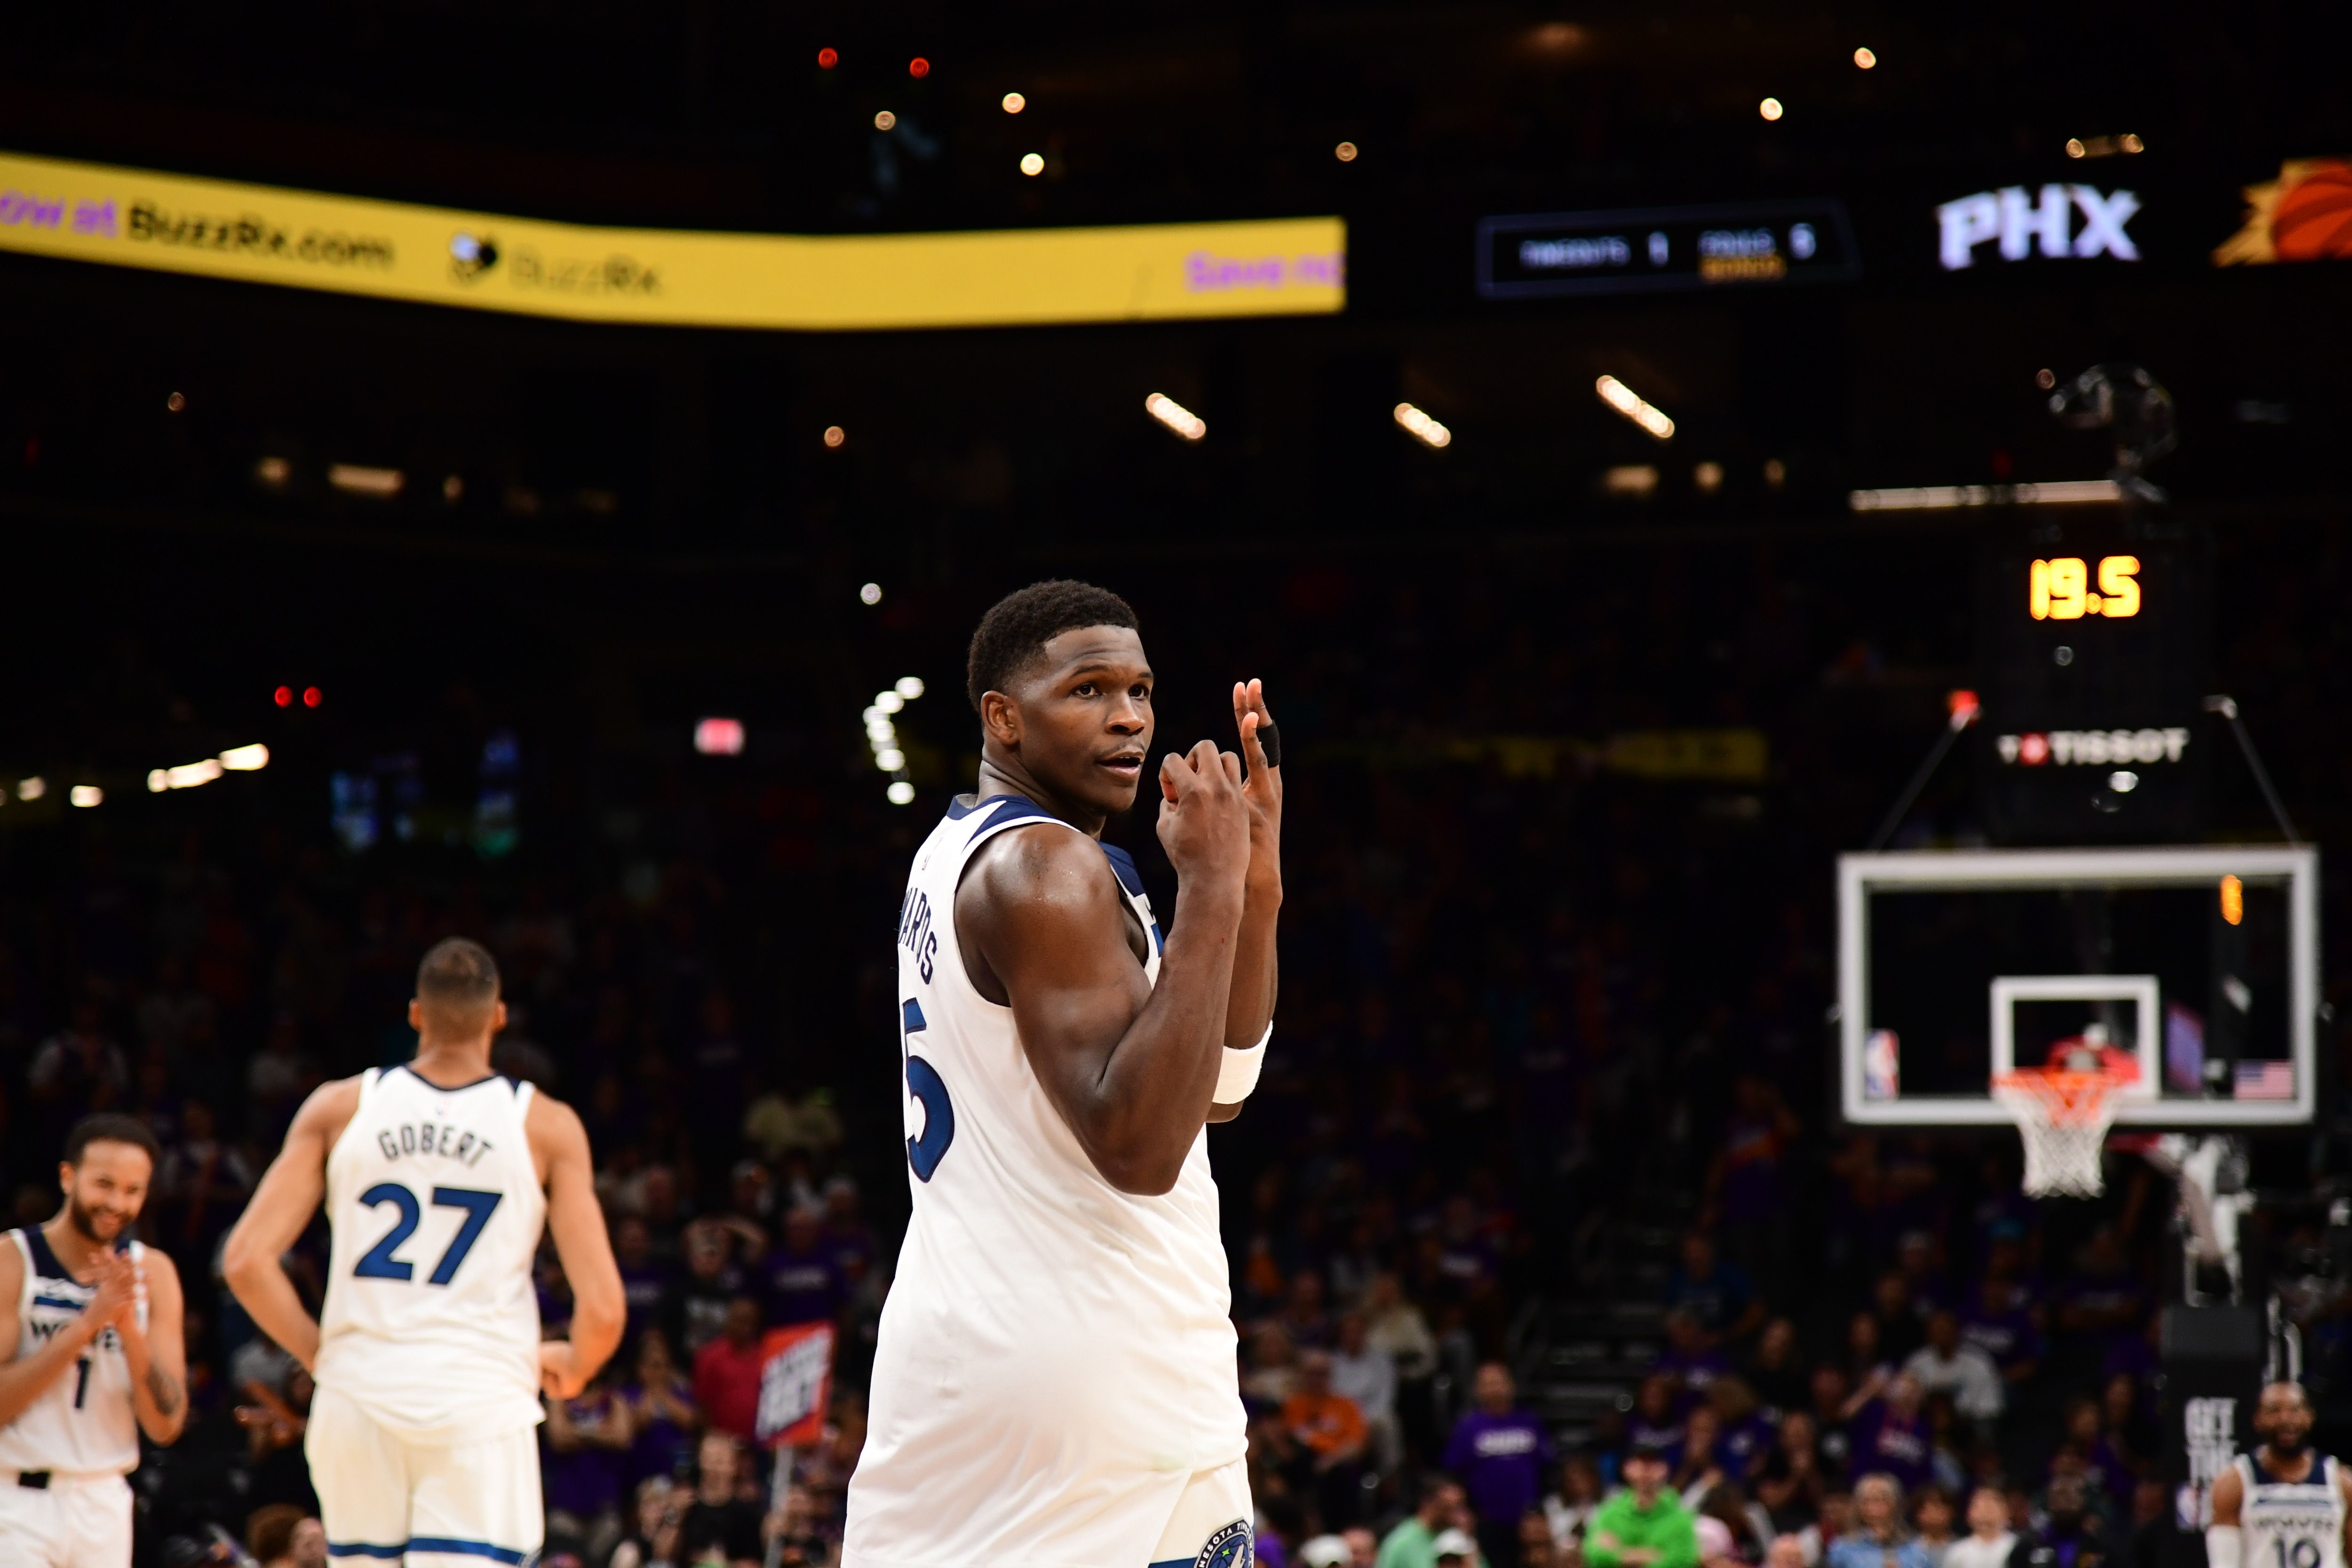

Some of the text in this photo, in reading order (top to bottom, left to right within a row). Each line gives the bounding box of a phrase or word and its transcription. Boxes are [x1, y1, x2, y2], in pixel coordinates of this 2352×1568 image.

[127, 199, 395, 269] BuzzRx.com
[1936, 183, 2142, 270] PHX
[1184, 250, 1287, 293] Save
[2030, 556, 2140, 620] 19.5
[2049, 727, 2190, 765] TISSOT
[898, 887, 937, 985] ARDS
[903, 997, 954, 1184] 5
[377, 1123, 493, 1168] GOBERT
[353, 1183, 503, 1286] 27
[75, 1357, 92, 1409] 1
